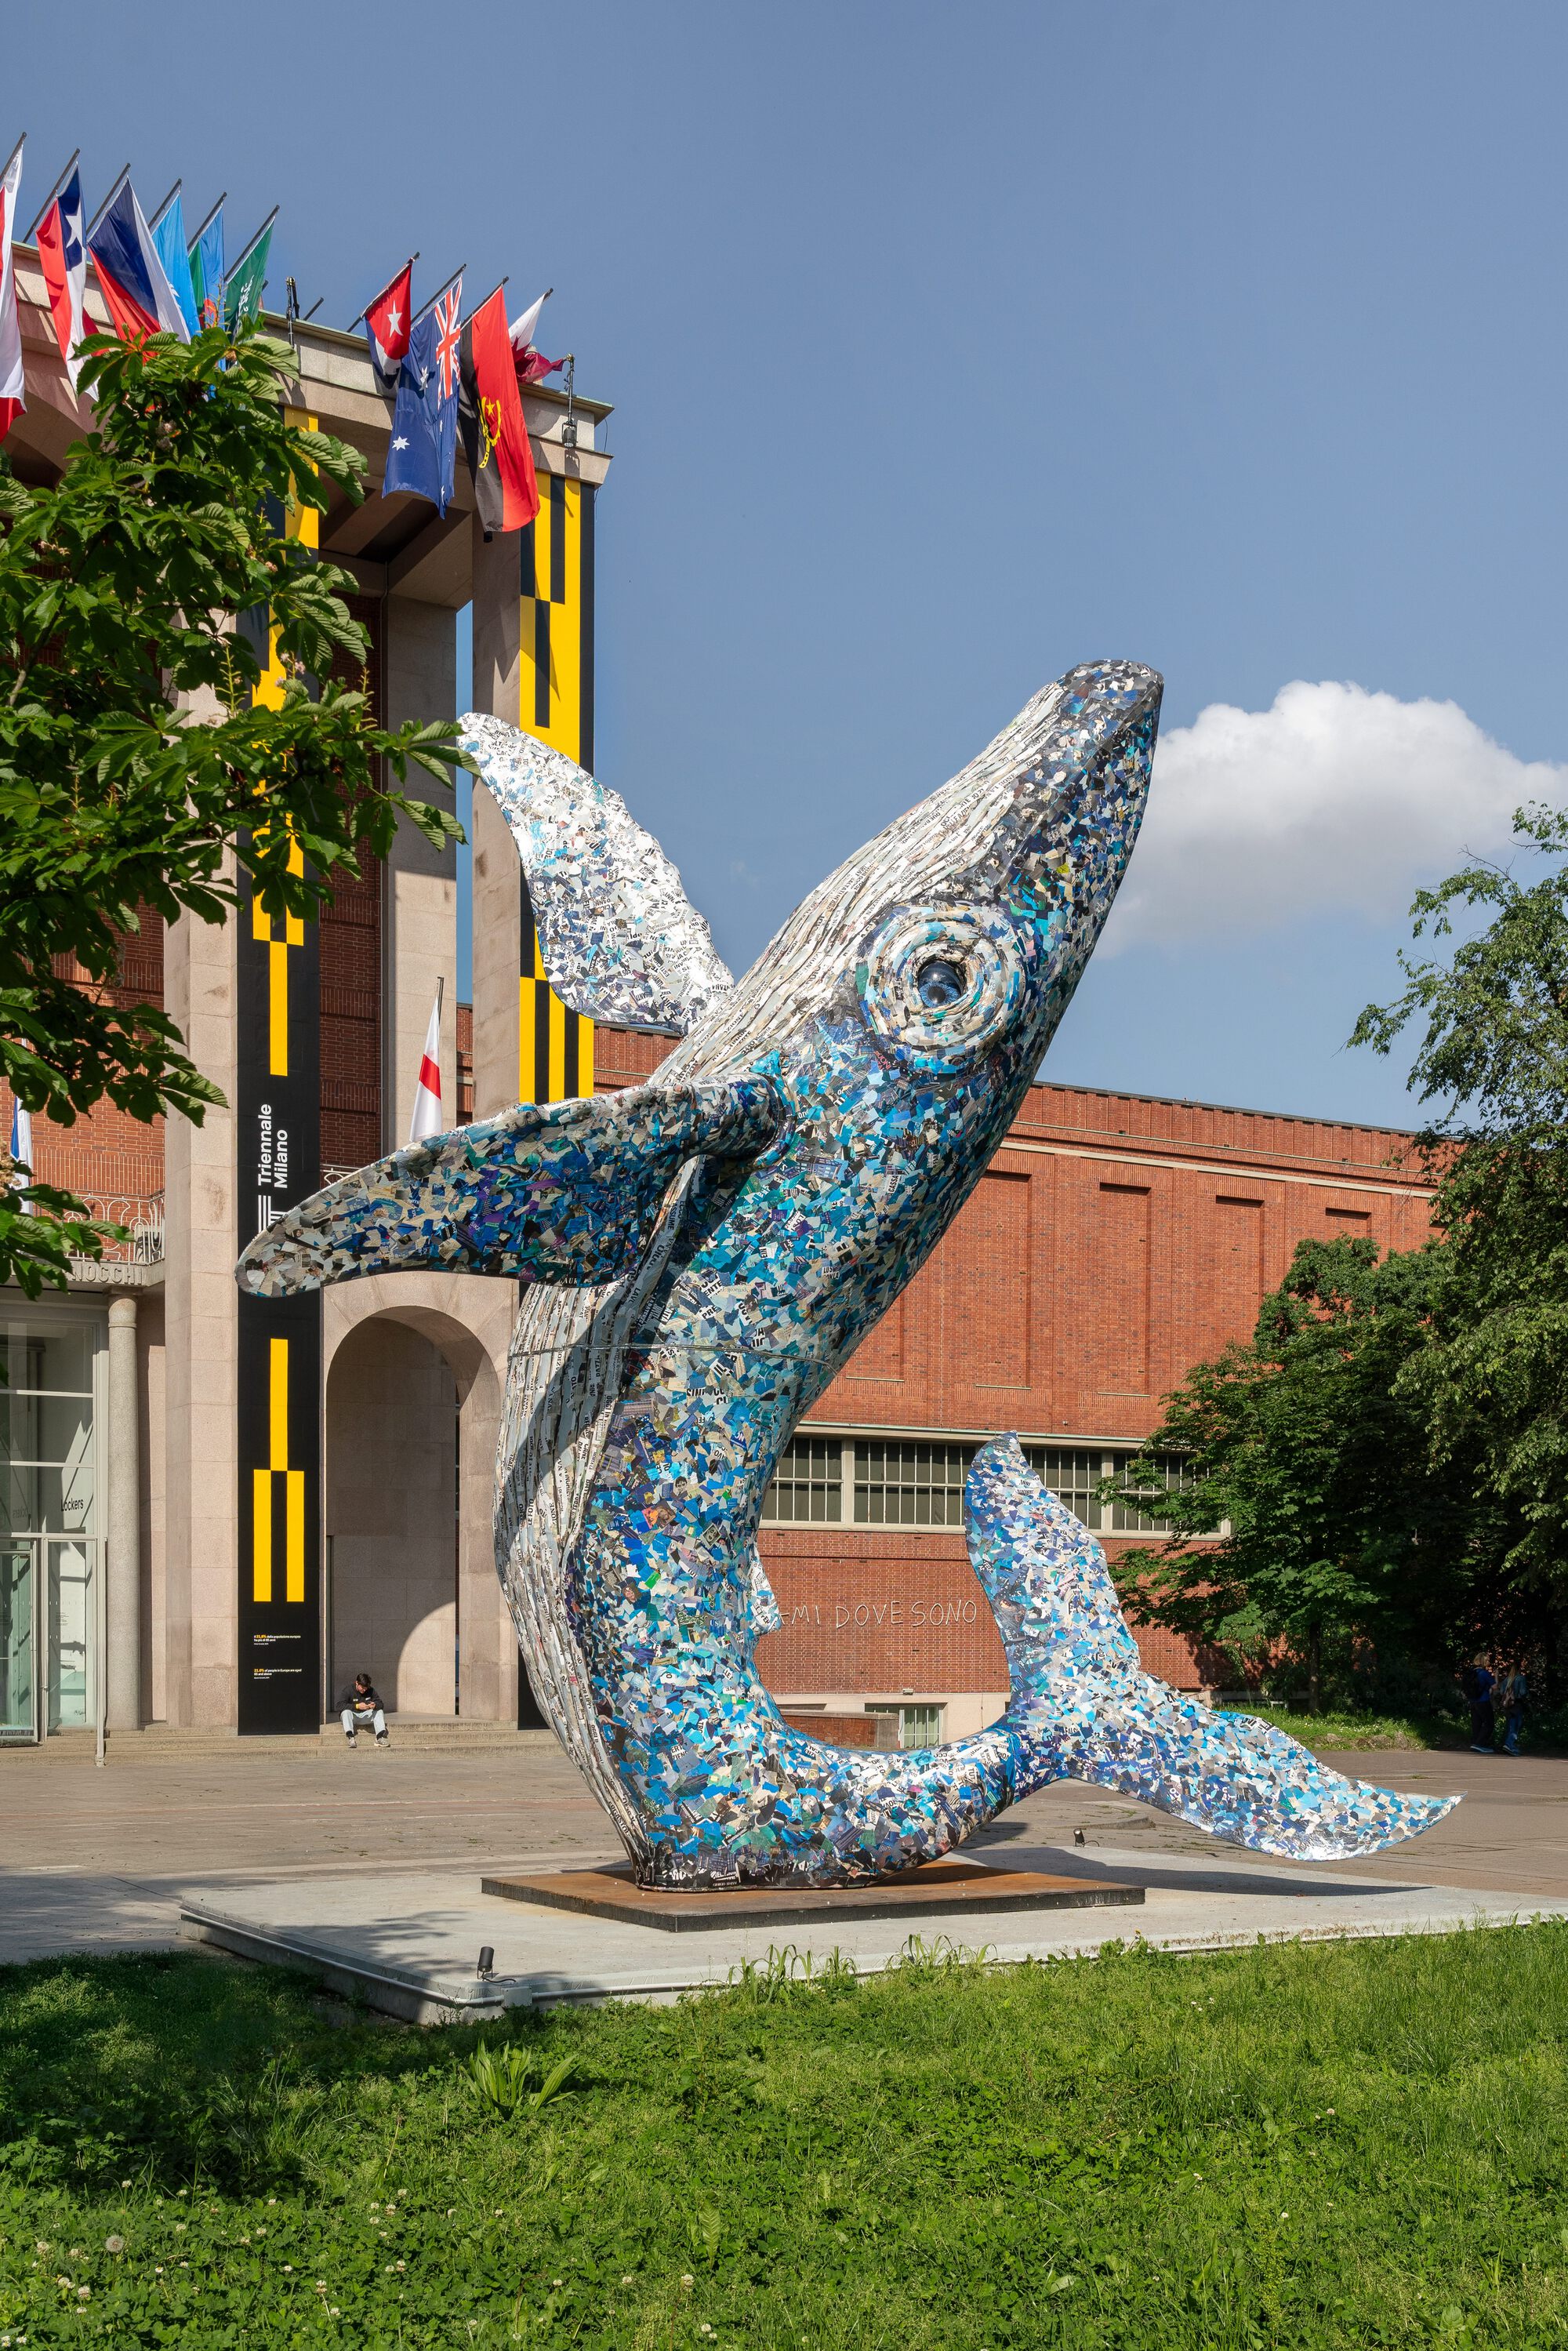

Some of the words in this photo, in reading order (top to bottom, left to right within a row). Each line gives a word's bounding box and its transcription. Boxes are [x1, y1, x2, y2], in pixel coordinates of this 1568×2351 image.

[258, 1103, 271, 1186] Triennale
[274, 1129, 288, 1189] Milano
[71, 1263, 143, 1285] NOCCHI
[60, 1498, 84, 1512] Lockers
[836, 1601, 903, 1629] DOVE
[912, 1600, 977, 1627] SONO
